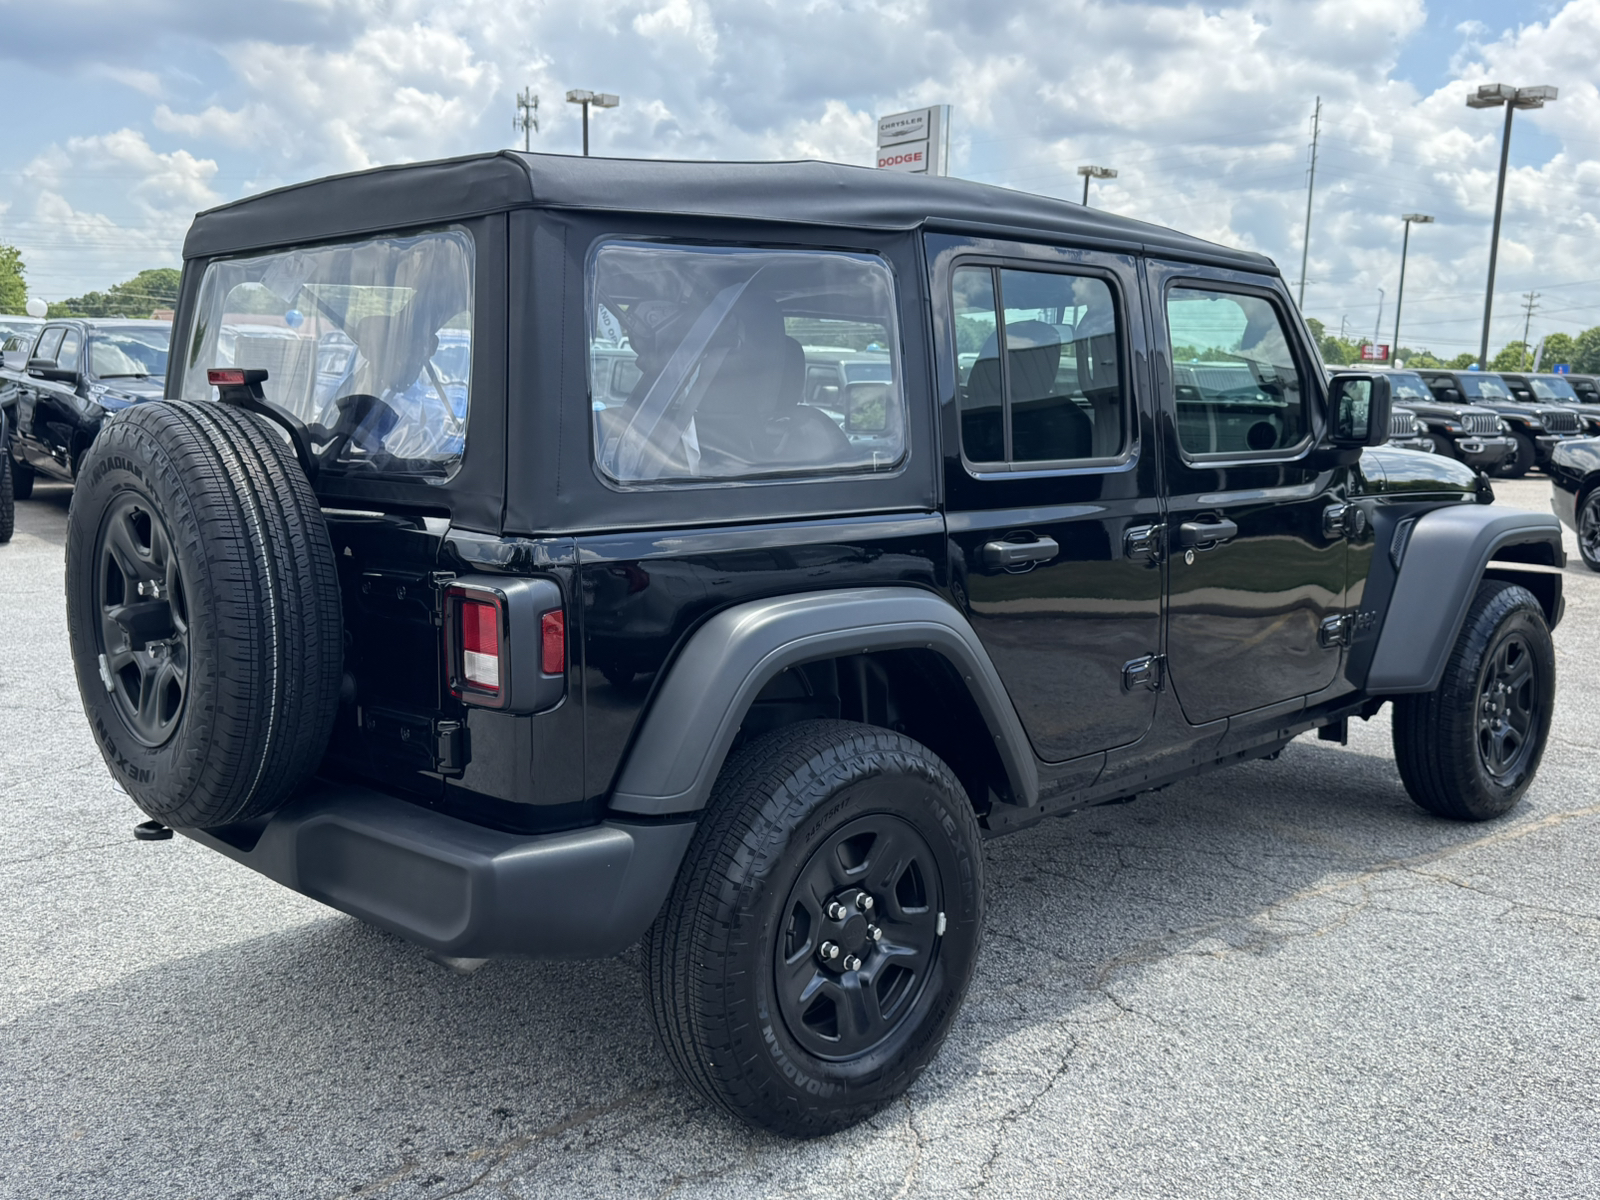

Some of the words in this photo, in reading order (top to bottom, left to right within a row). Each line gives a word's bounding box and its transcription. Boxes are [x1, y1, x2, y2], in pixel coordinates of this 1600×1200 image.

[880, 117, 922, 131] CHRYSLER
[878, 152, 922, 168] DODGE
[92, 455, 143, 485] ROADIAN
[1353, 609, 1377, 631] Jeep
[96, 717, 151, 784] NEXEN
[805, 796, 851, 843] 245/75R17
[928, 800, 973, 904] NEXEN
[762, 1024, 836, 1099] ROADIAN
